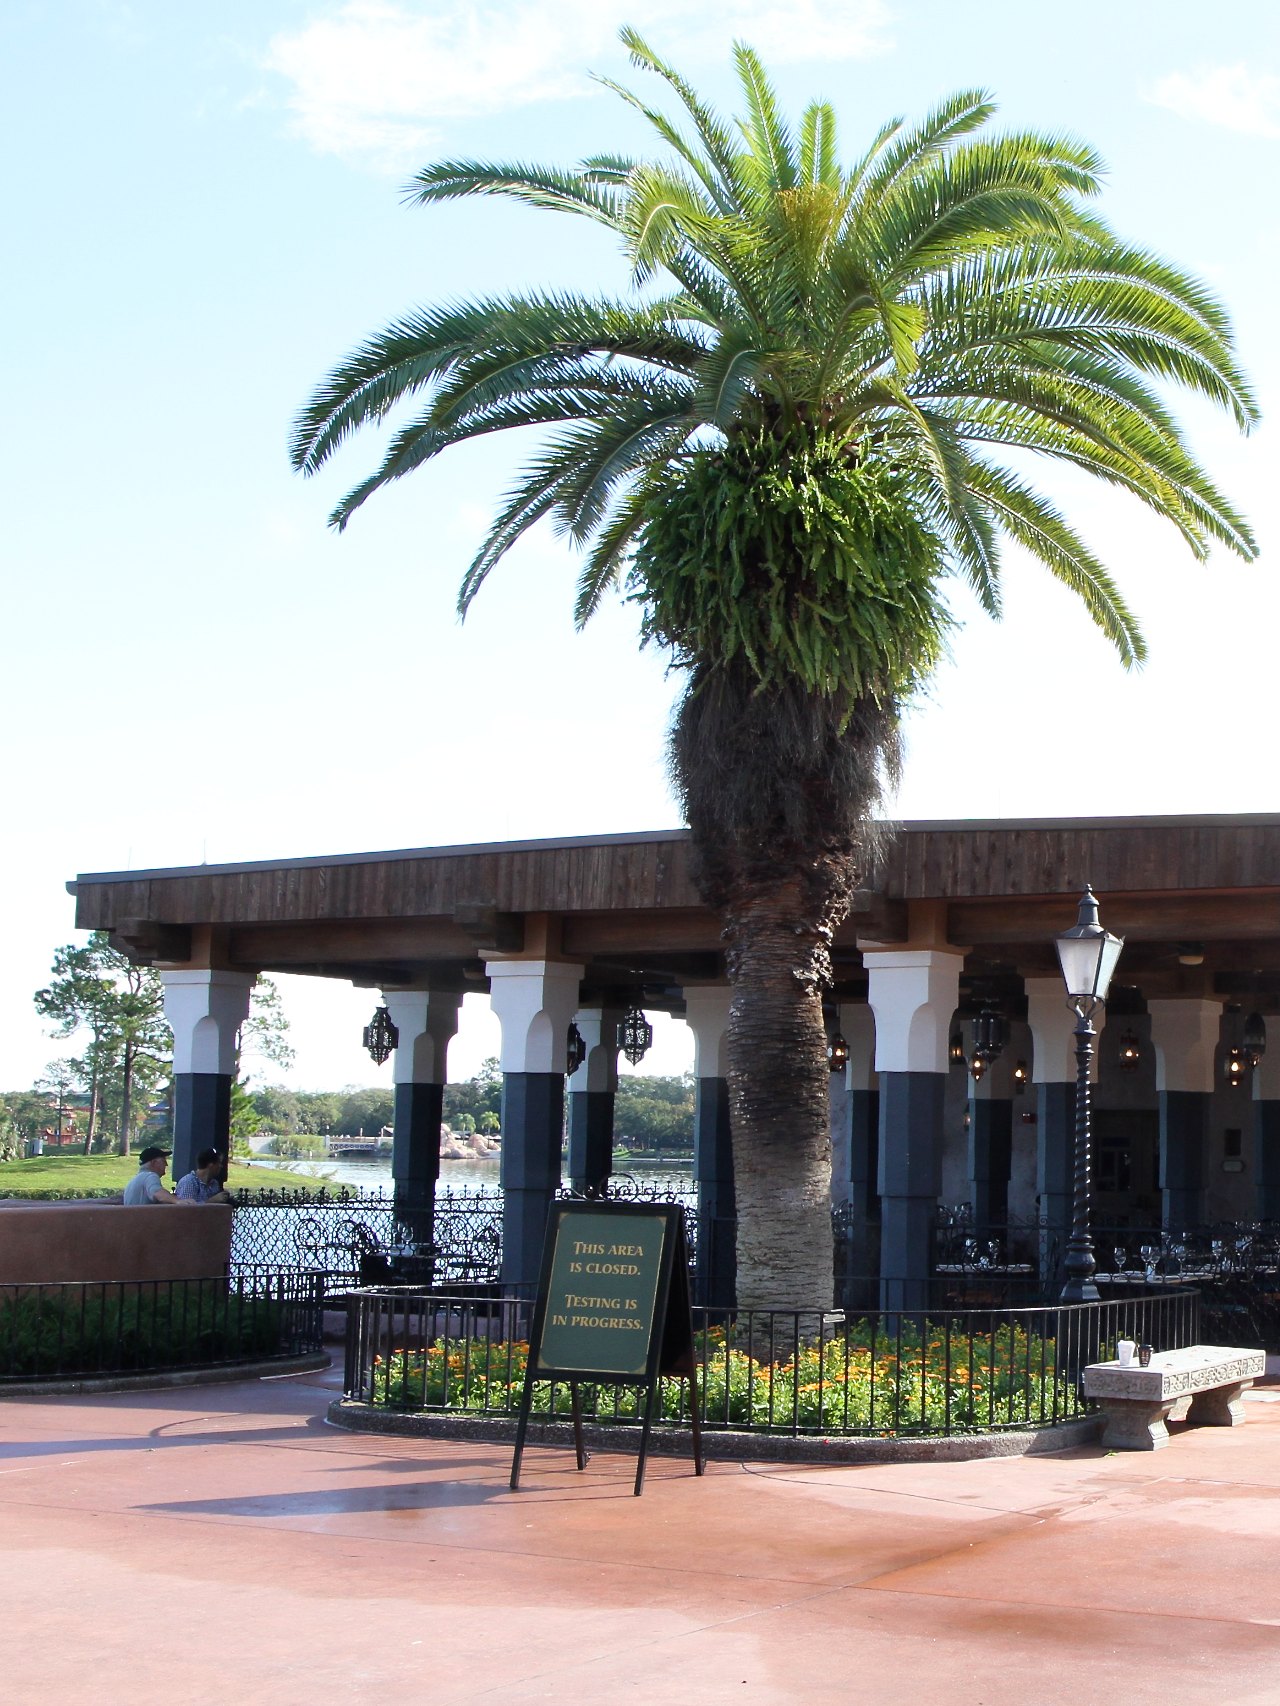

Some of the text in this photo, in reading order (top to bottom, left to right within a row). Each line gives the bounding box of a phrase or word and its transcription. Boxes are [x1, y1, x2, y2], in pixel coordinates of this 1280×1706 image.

[573, 1241, 644, 1257] THIS AREA
[569, 1262, 641, 1276] IS CLOSED.
[565, 1294, 638, 1310] TESTING IS
[552, 1314, 644, 1330] IN PROGRESS.
